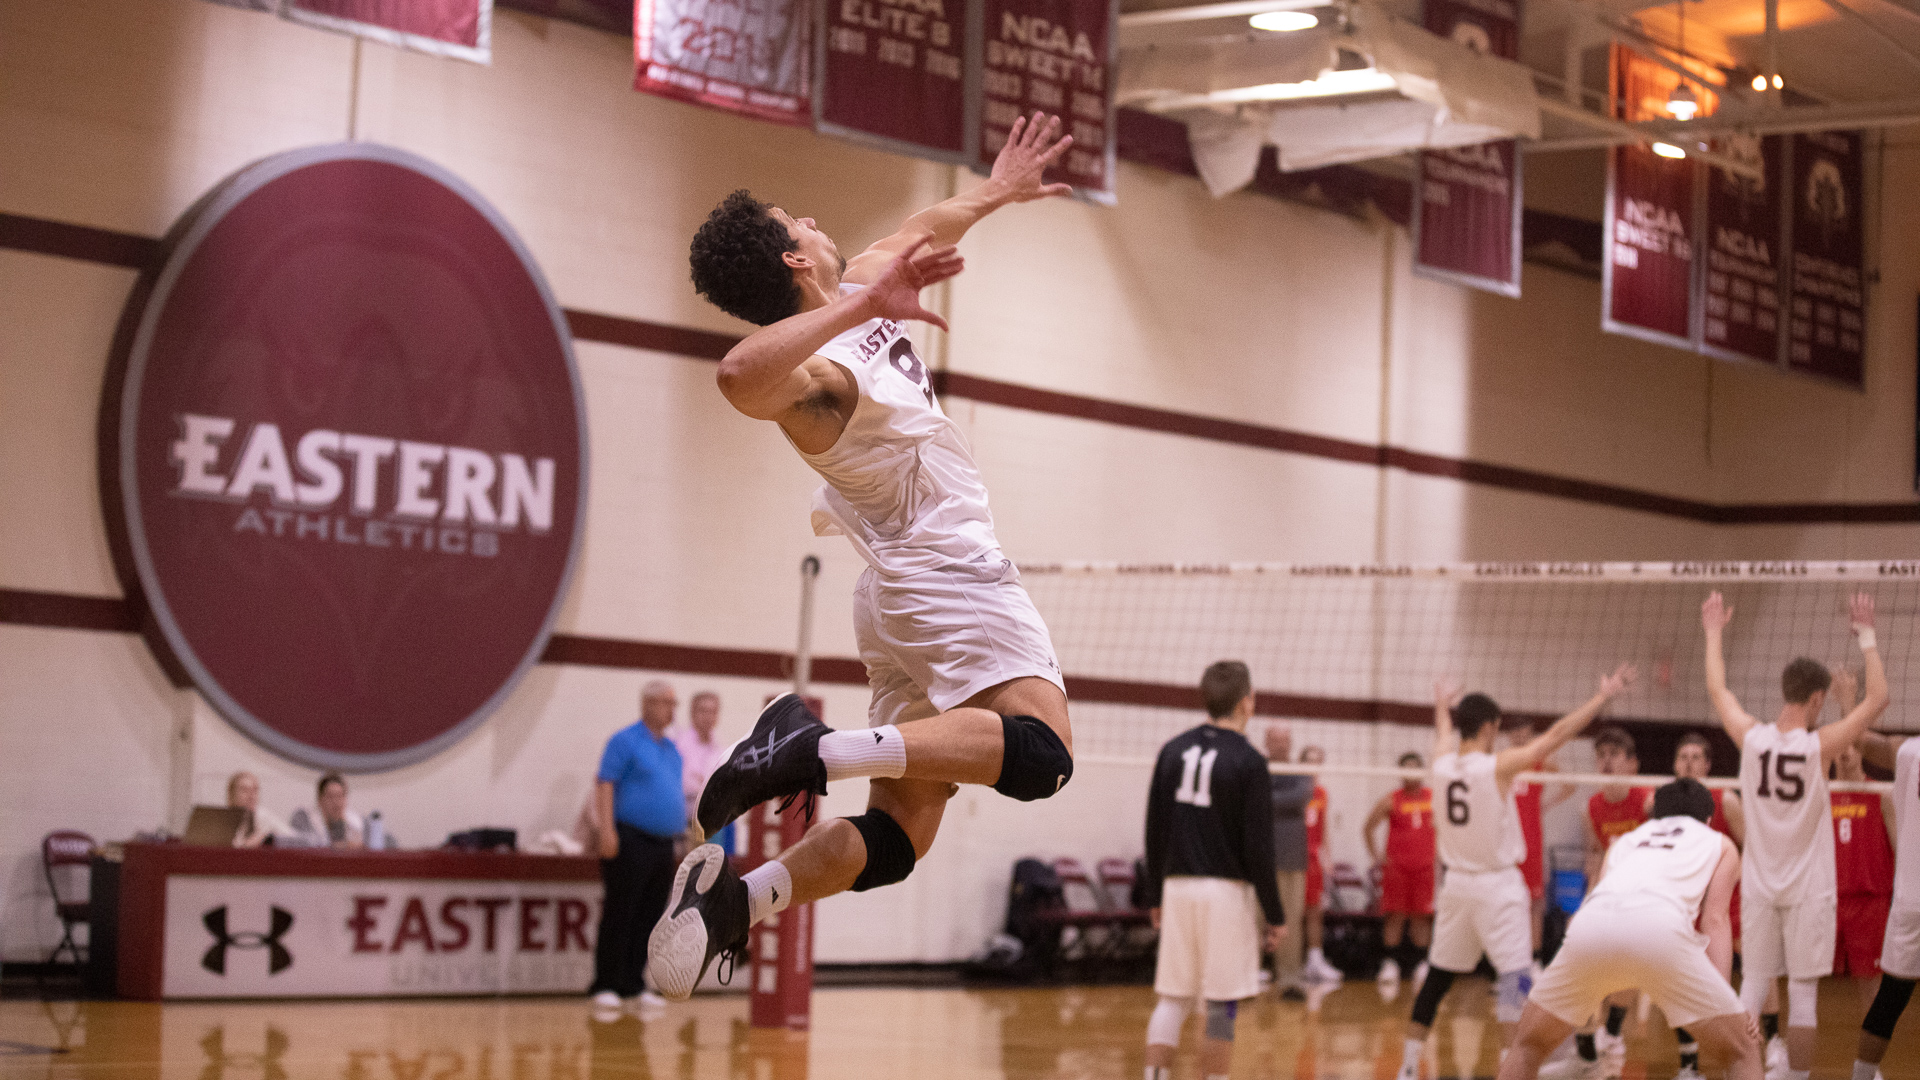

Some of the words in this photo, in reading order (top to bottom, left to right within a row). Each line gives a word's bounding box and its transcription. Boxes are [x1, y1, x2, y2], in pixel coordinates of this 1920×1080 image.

[841, 0, 926, 38] ELITE
[1001, 10, 1095, 61] NCAA
[987, 40, 1075, 81] SWEET
[1623, 197, 1686, 236] NCAA
[1716, 226, 1772, 265] NCAA
[850, 317, 899, 365] EASTE
[888, 335, 935, 410] 9
[172, 413, 556, 533] EASTERN
[233, 508, 501, 558] ATHLETICS
[1671, 562, 1741, 576] EASTERN
[1750, 562, 1808, 576] EAGLES
[1878, 562, 1920, 576] EAST
[1175, 744, 1218, 808] 11
[1757, 749, 1807, 803] 15
[1446, 779, 1470, 827] 6
[347, 896, 592, 953] EASTER
